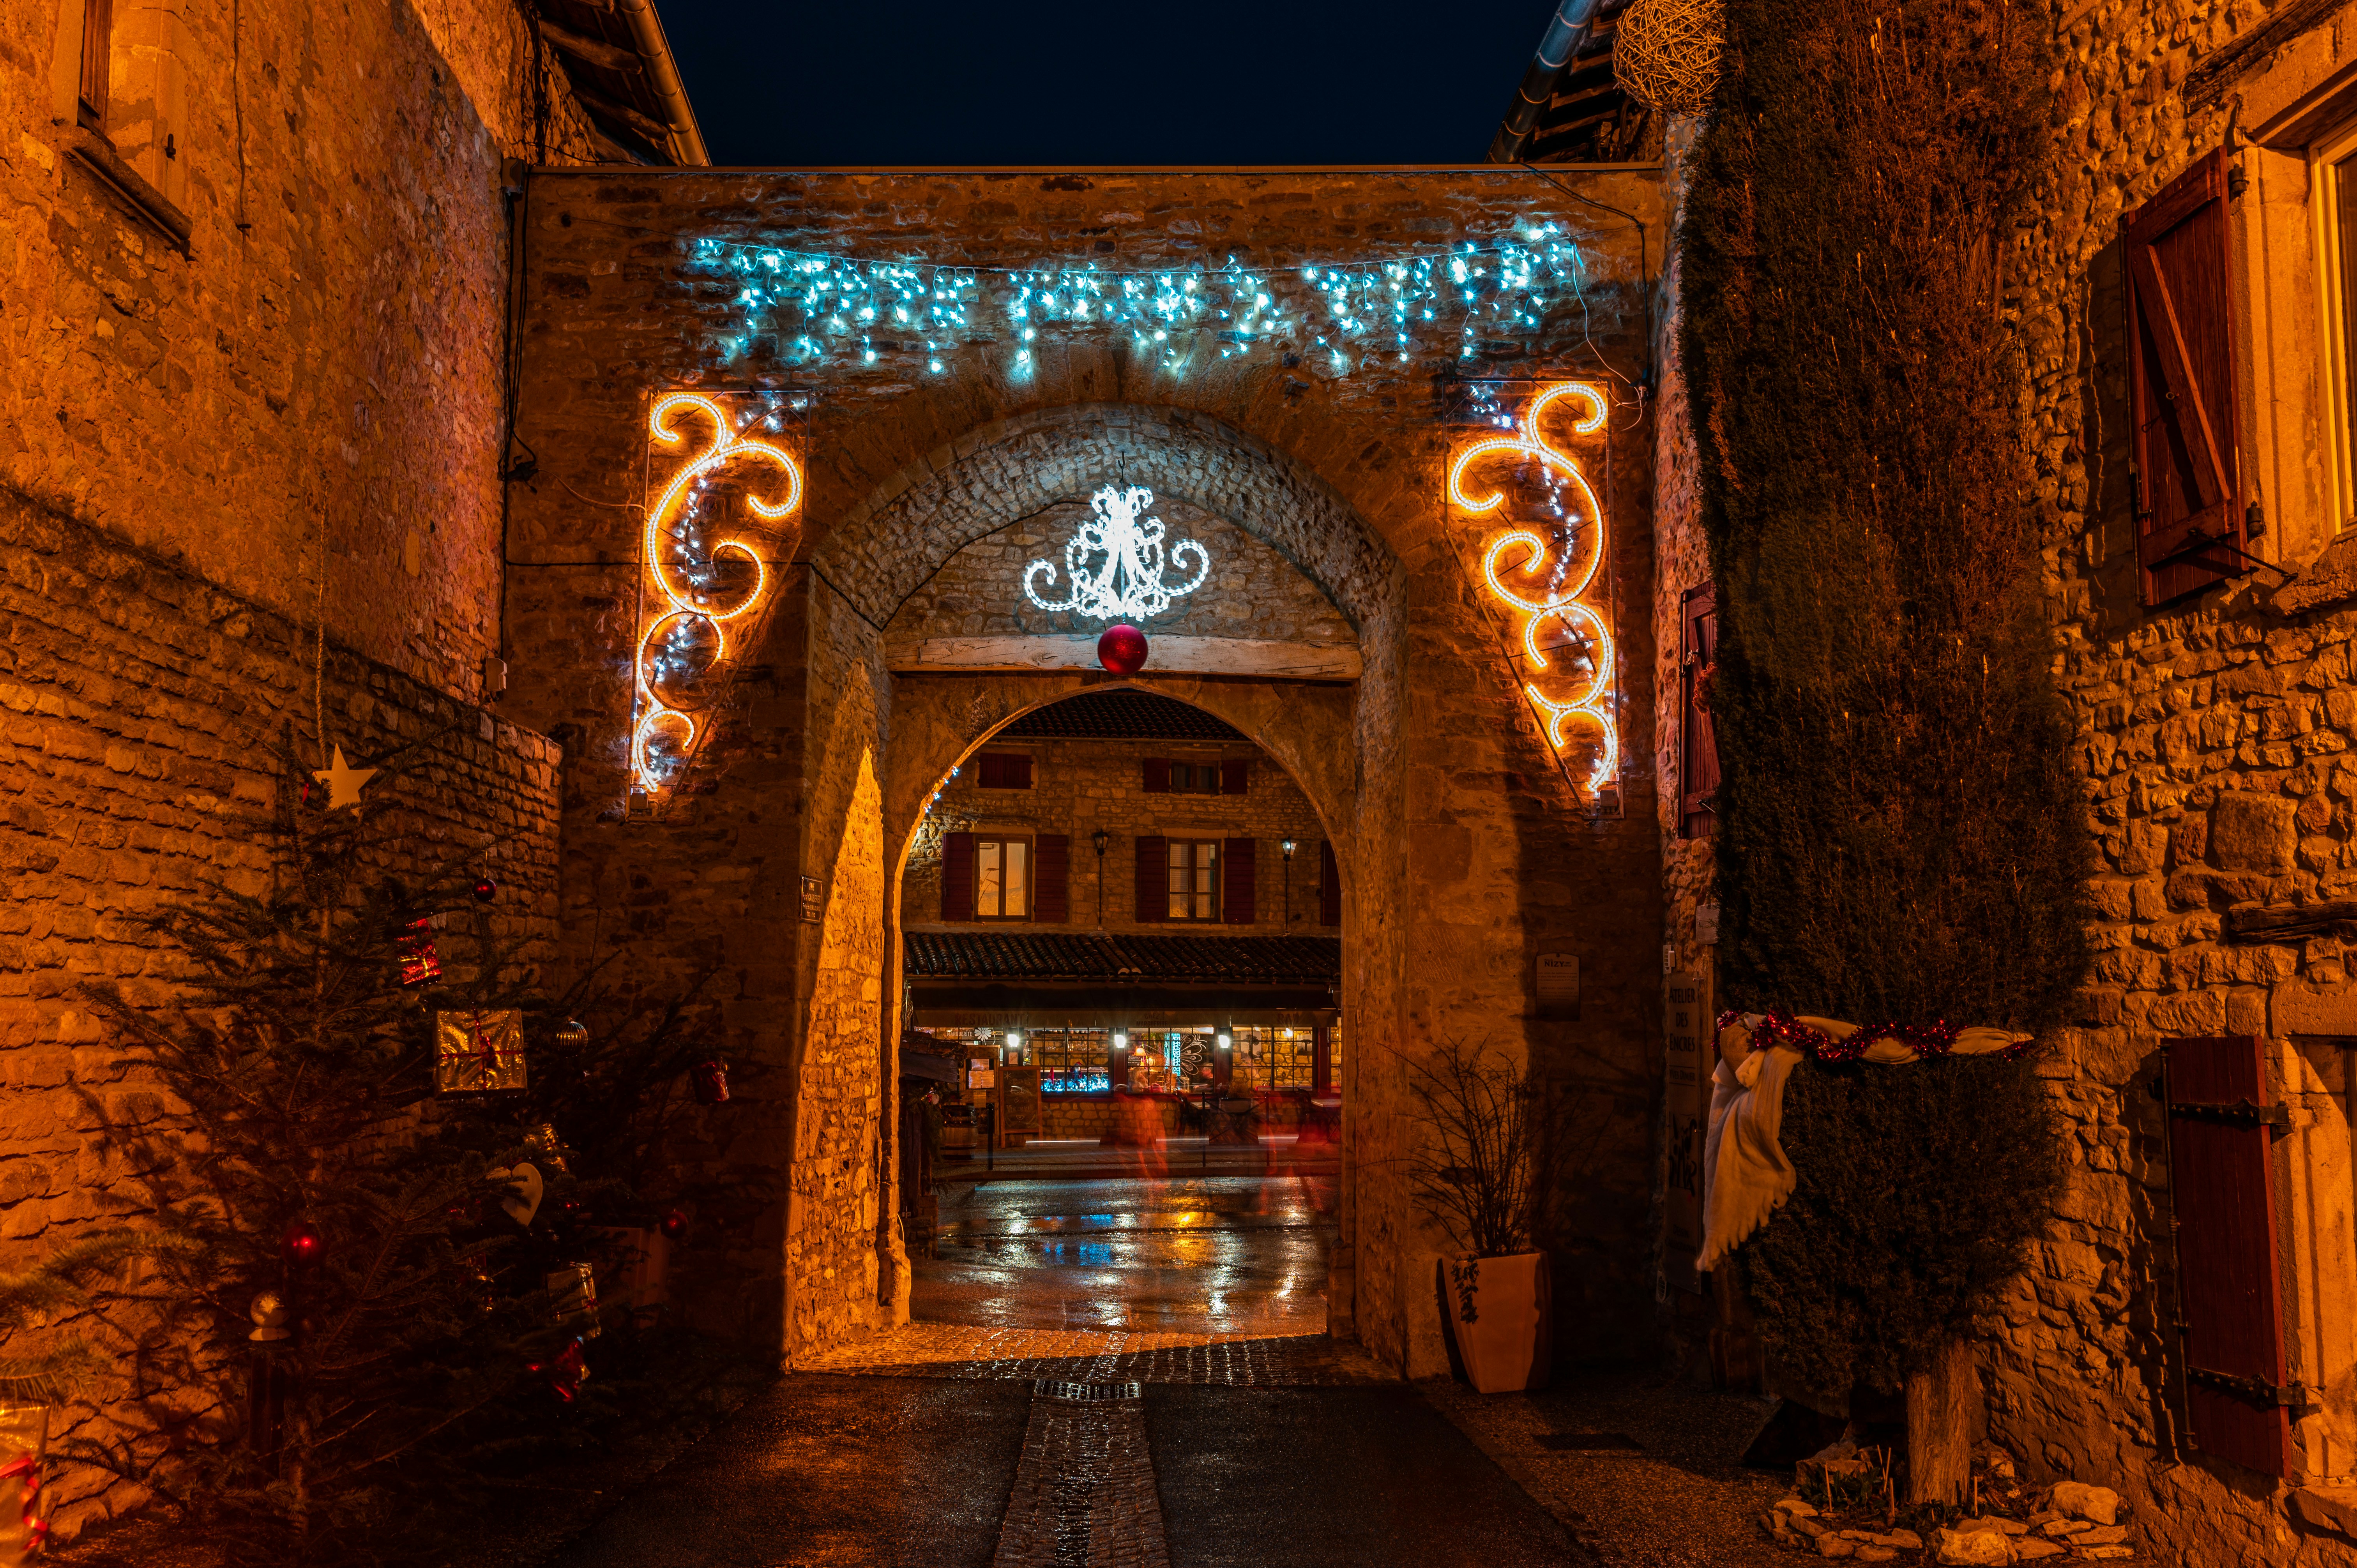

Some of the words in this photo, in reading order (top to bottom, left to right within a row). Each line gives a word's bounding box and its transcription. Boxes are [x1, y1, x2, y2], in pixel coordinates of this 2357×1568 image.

[1669, 987, 1695, 1003] ATELIER
[956, 1014, 1024, 1025] RESTAURANT
[1676, 1012, 1688, 1028] DES
[1670, 1033, 1695, 1052] ENCRES
[1669, 1069, 1679, 1079] YVES
[1673, 1224, 1689, 1238] DESSIN
